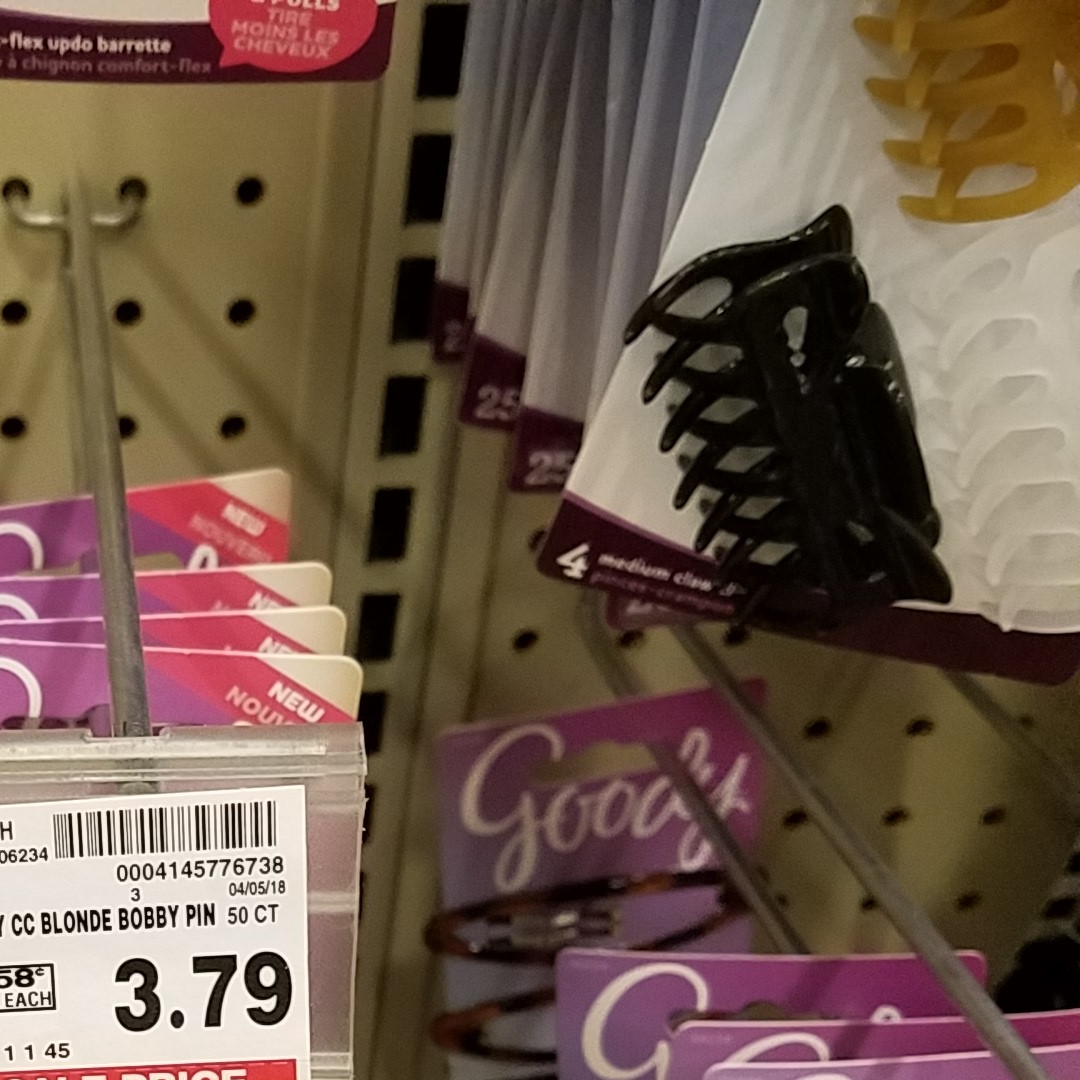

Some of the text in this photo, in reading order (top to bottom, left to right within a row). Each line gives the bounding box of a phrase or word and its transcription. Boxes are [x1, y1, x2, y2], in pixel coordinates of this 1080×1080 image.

[268, 8, 313, 26] TIRE
[231, 20, 340, 46] MOINS LES
[48, 35, 93, 56] updo
[97, 35, 172, 54] barrette
[233, 36, 331, 60] CHEVEUX
[22, 54, 92, 75] chignon
[556, 542, 670, 582] 4 medium
[268, 681, 325, 724] NEW
[116, 856, 284, 882] 0004145776738
[130, 881, 286, 902] 3 04/05/18
[11, 912, 36, 937] CC
[41, 908, 112, 935] BLONDE
[118, 904, 180, 931] BOBBY
[186, 902, 216, 927] PIN
[228, 906, 249, 925] 50
[254, 904, 280, 924] CT
[4, 990, 52, 1008] EACH
[114, 951, 292, 1032] 3.79
[4, 1046, 14, 1062] 1
[25, 1044, 34, 1061] 1
[44, 1042, 71, 1060] 45
